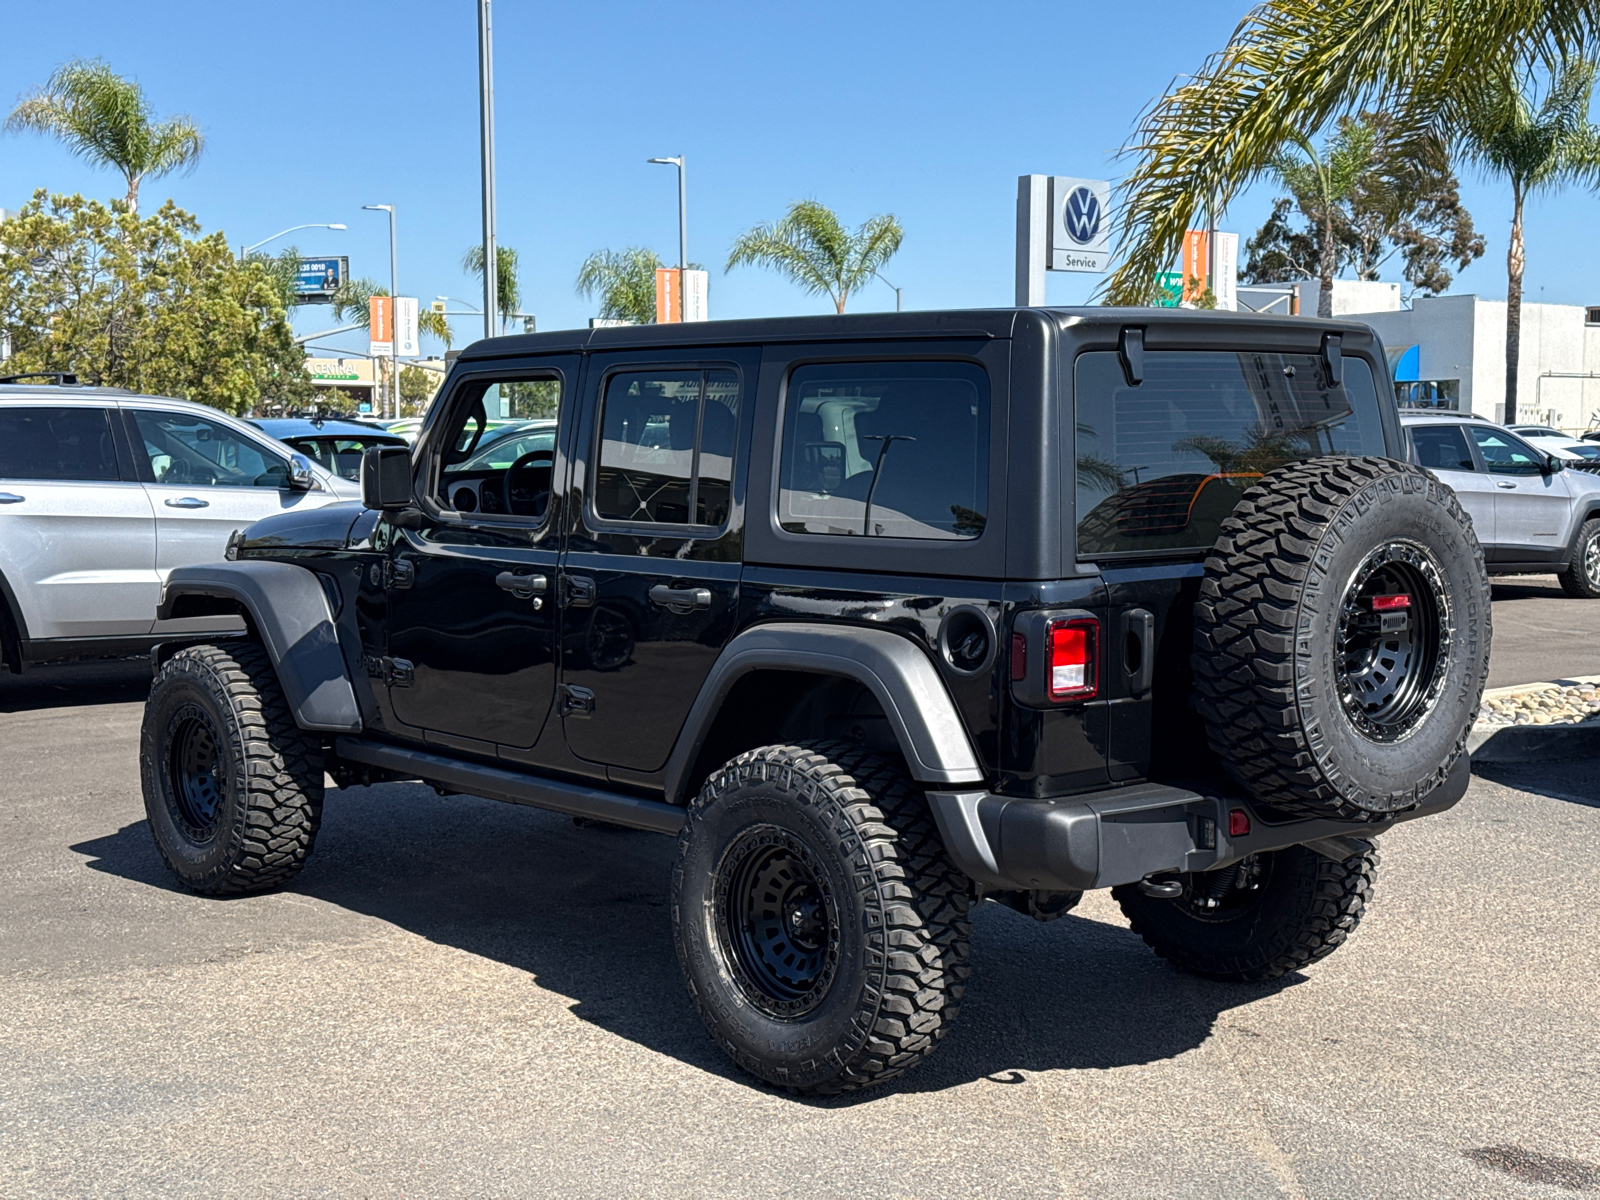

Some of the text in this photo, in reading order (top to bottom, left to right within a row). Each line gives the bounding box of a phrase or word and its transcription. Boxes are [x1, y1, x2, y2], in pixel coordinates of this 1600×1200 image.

[1066, 254, 1097, 268] Service
[314, 363, 358, 375] CENTRAL
[1456, 571, 1480, 705] THOMPSON
[356, 651, 383, 675] Jeep
